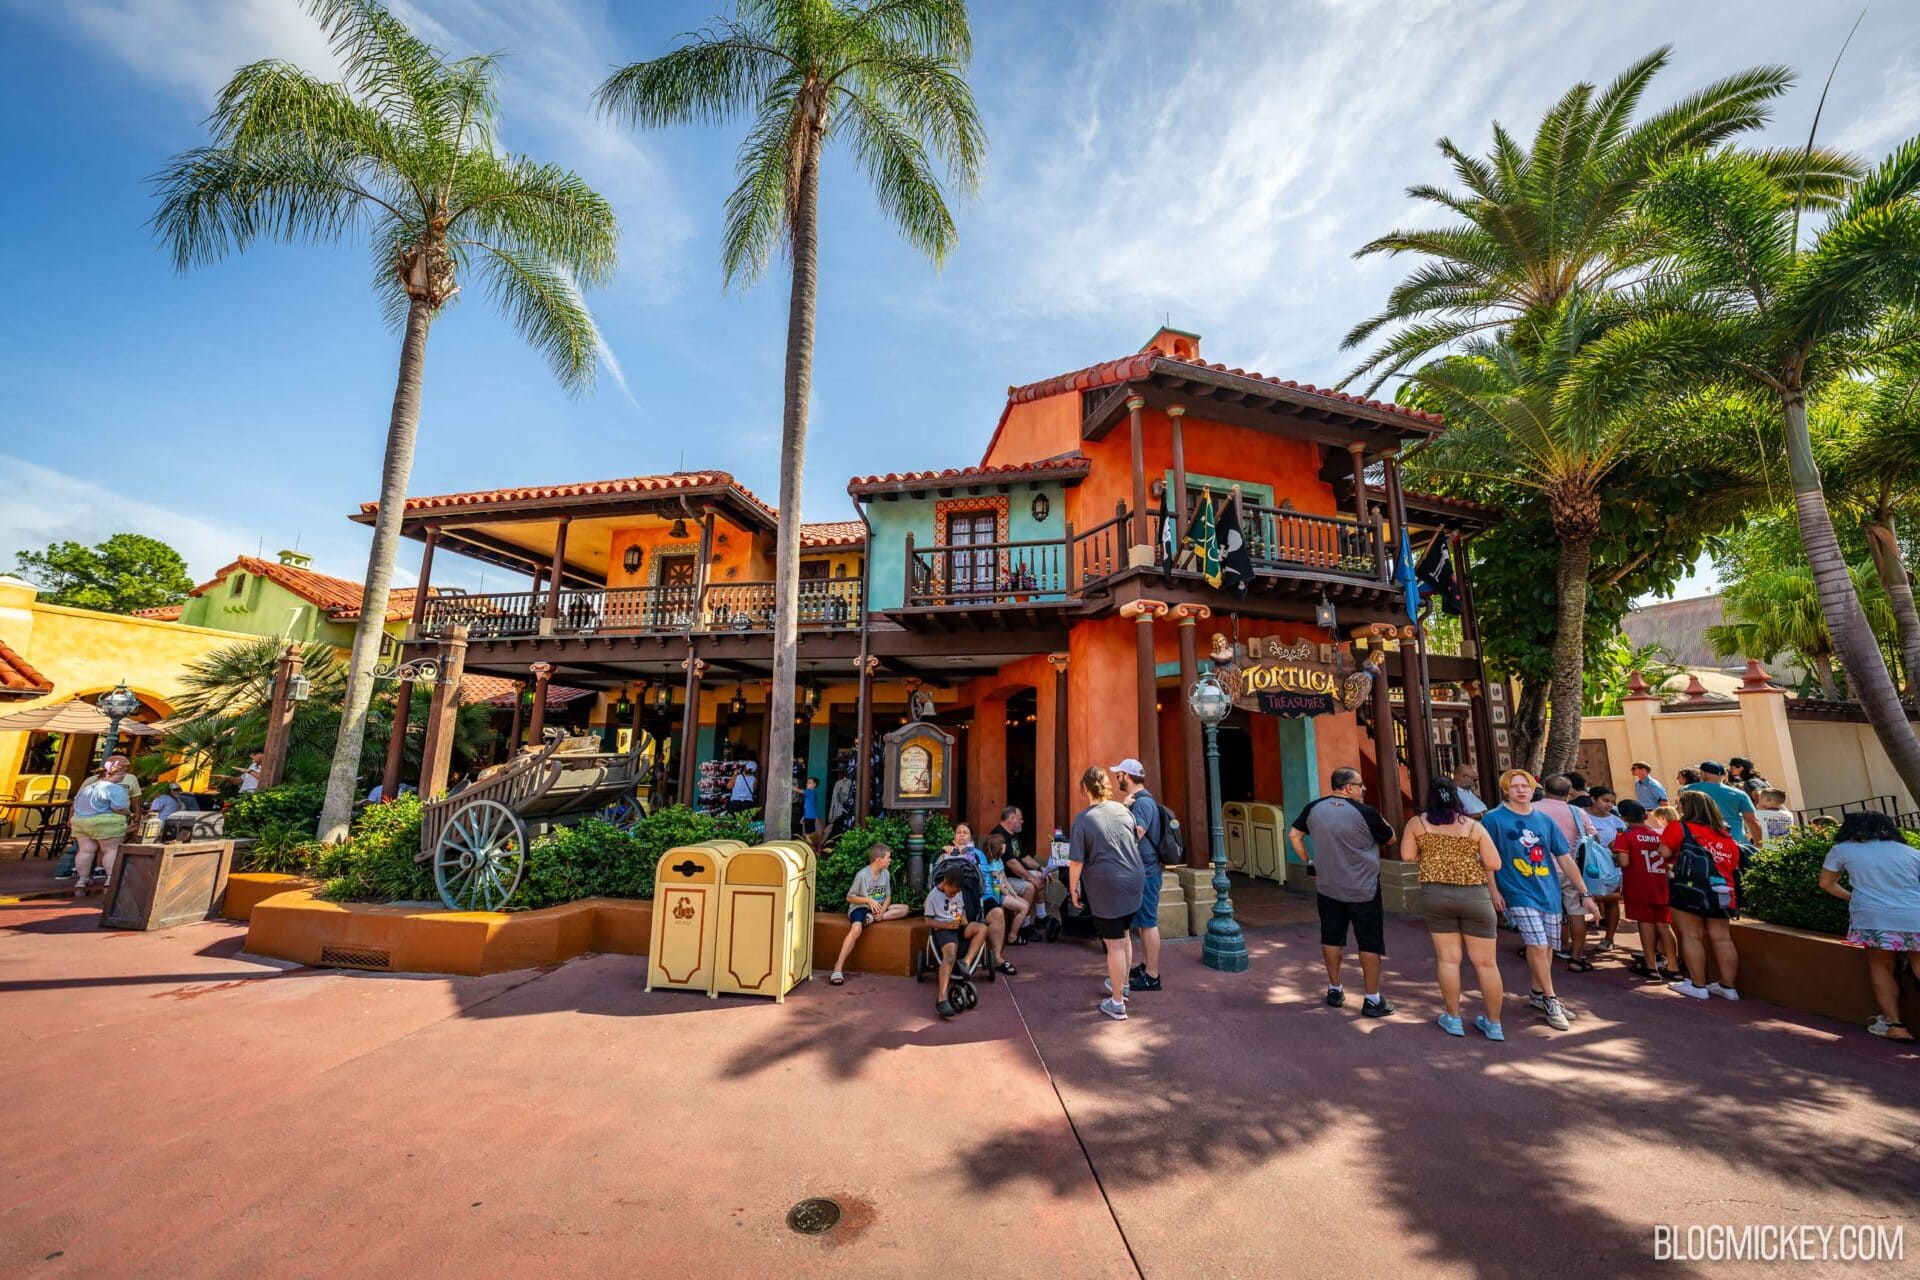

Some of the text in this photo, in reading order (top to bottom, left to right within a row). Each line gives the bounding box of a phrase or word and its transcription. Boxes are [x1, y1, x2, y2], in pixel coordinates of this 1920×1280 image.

[1241, 664, 1340, 701] TORTUGA
[1265, 694, 1326, 710] TREASURES
[1641, 849, 1666, 874] 12
